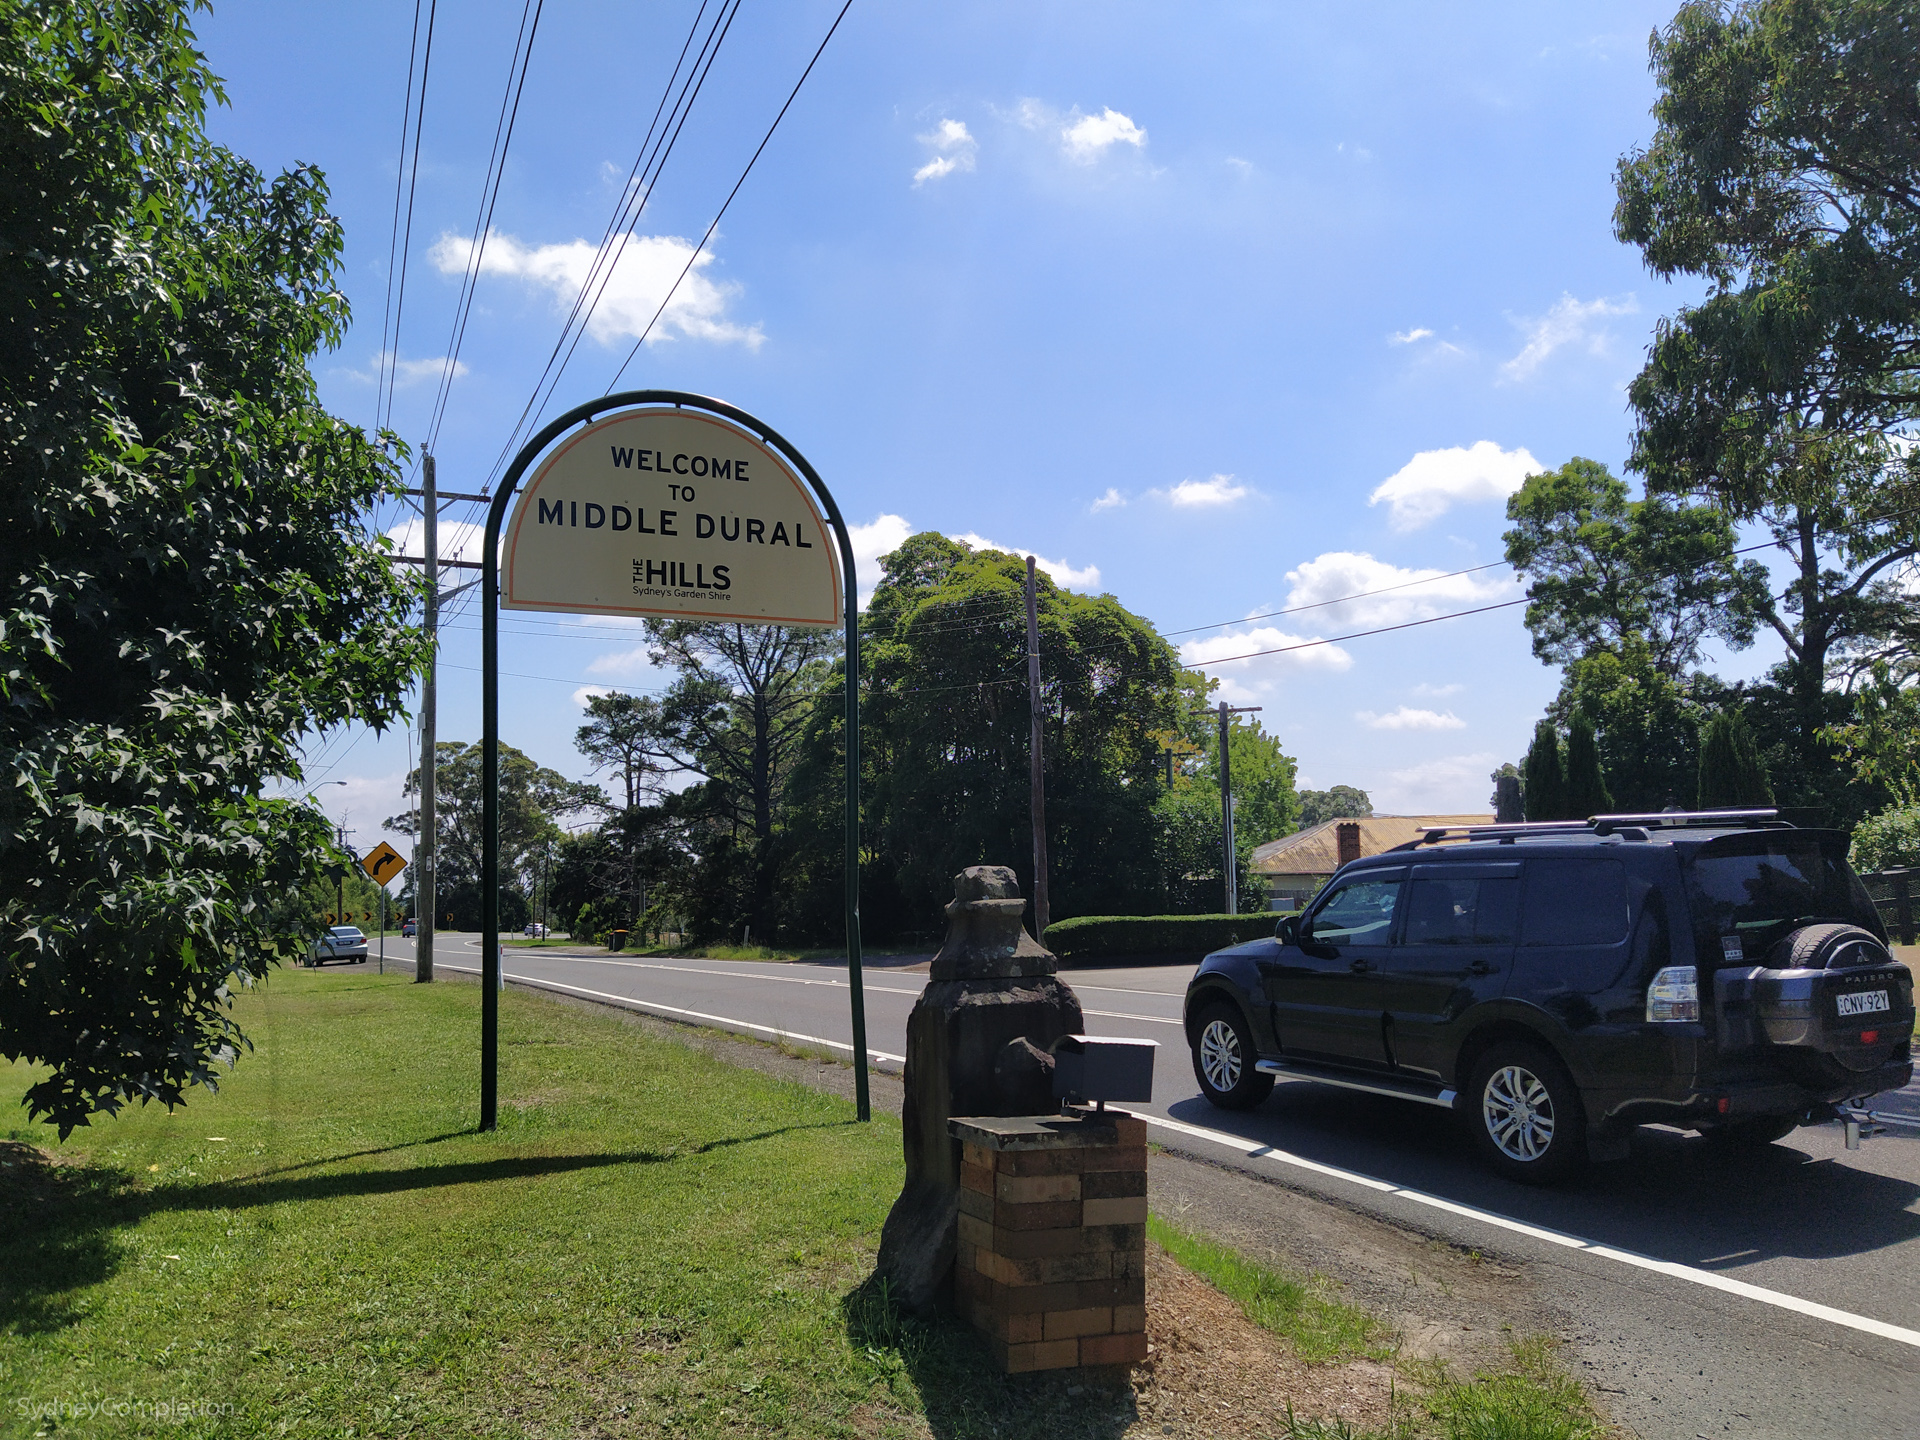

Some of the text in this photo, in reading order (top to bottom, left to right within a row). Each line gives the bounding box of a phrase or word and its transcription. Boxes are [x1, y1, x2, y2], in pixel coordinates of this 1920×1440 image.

[610, 445, 750, 482] WELCOME
[667, 484, 696, 502] TO
[538, 498, 812, 549] MIDDLE DURAL
[632, 558, 731, 590] THE HILLS
[632, 585, 732, 601] Sydney's Garden Shire
[1845, 972, 1894, 983] PAJERO
